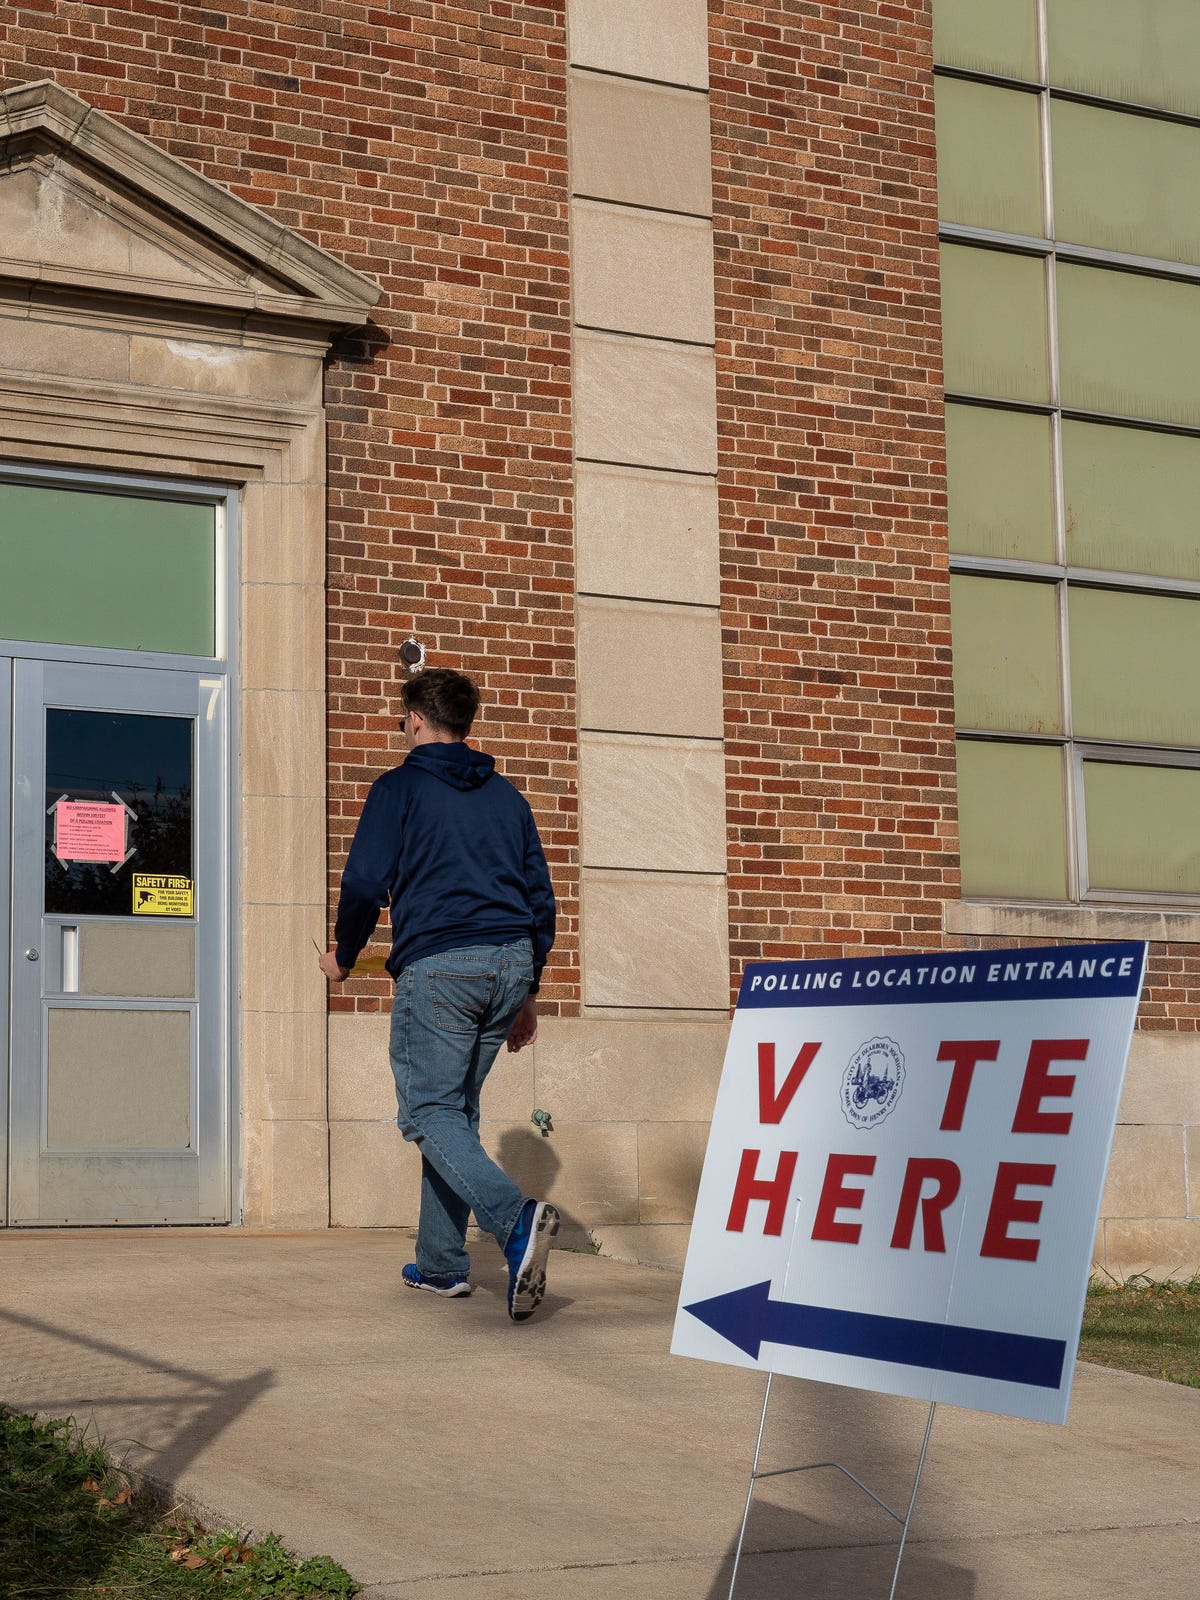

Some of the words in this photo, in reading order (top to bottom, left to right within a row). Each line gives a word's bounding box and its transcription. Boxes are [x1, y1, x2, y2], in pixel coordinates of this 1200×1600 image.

[136, 877, 166, 887] SAFETY
[168, 879, 190, 889] FIRST
[750, 972, 842, 992] POLLING
[852, 965, 975, 988] LOCATION
[987, 956, 1134, 983] ENTRANCE
[847, 1066, 855, 1081] CITY
[861, 1043, 888, 1056] DEARBORN
[869, 1107, 887, 1122] HENRY
[887, 1088, 898, 1107] FORD
[726, 1149, 1056, 1262] HERE
